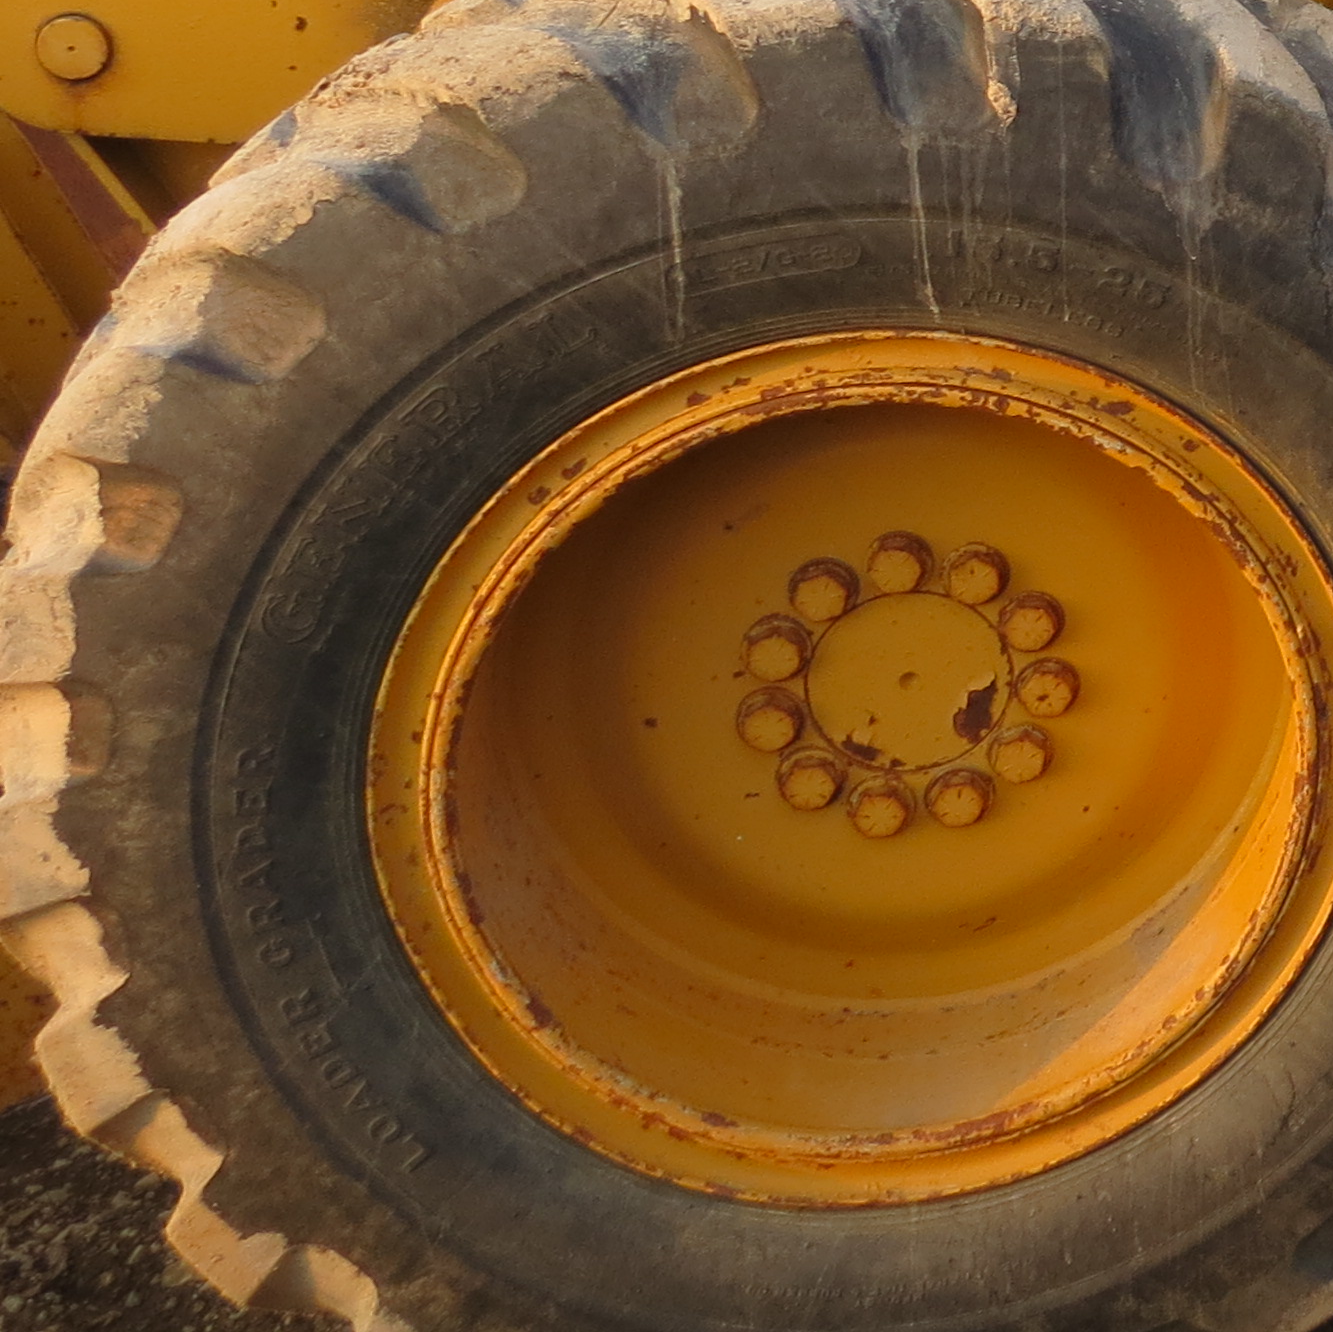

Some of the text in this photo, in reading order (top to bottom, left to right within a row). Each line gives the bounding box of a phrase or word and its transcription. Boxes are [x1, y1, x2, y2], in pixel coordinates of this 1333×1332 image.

[260, 313, 598, 645] GENERAL
[233, 746, 430, 1174] LOADER GRADER
